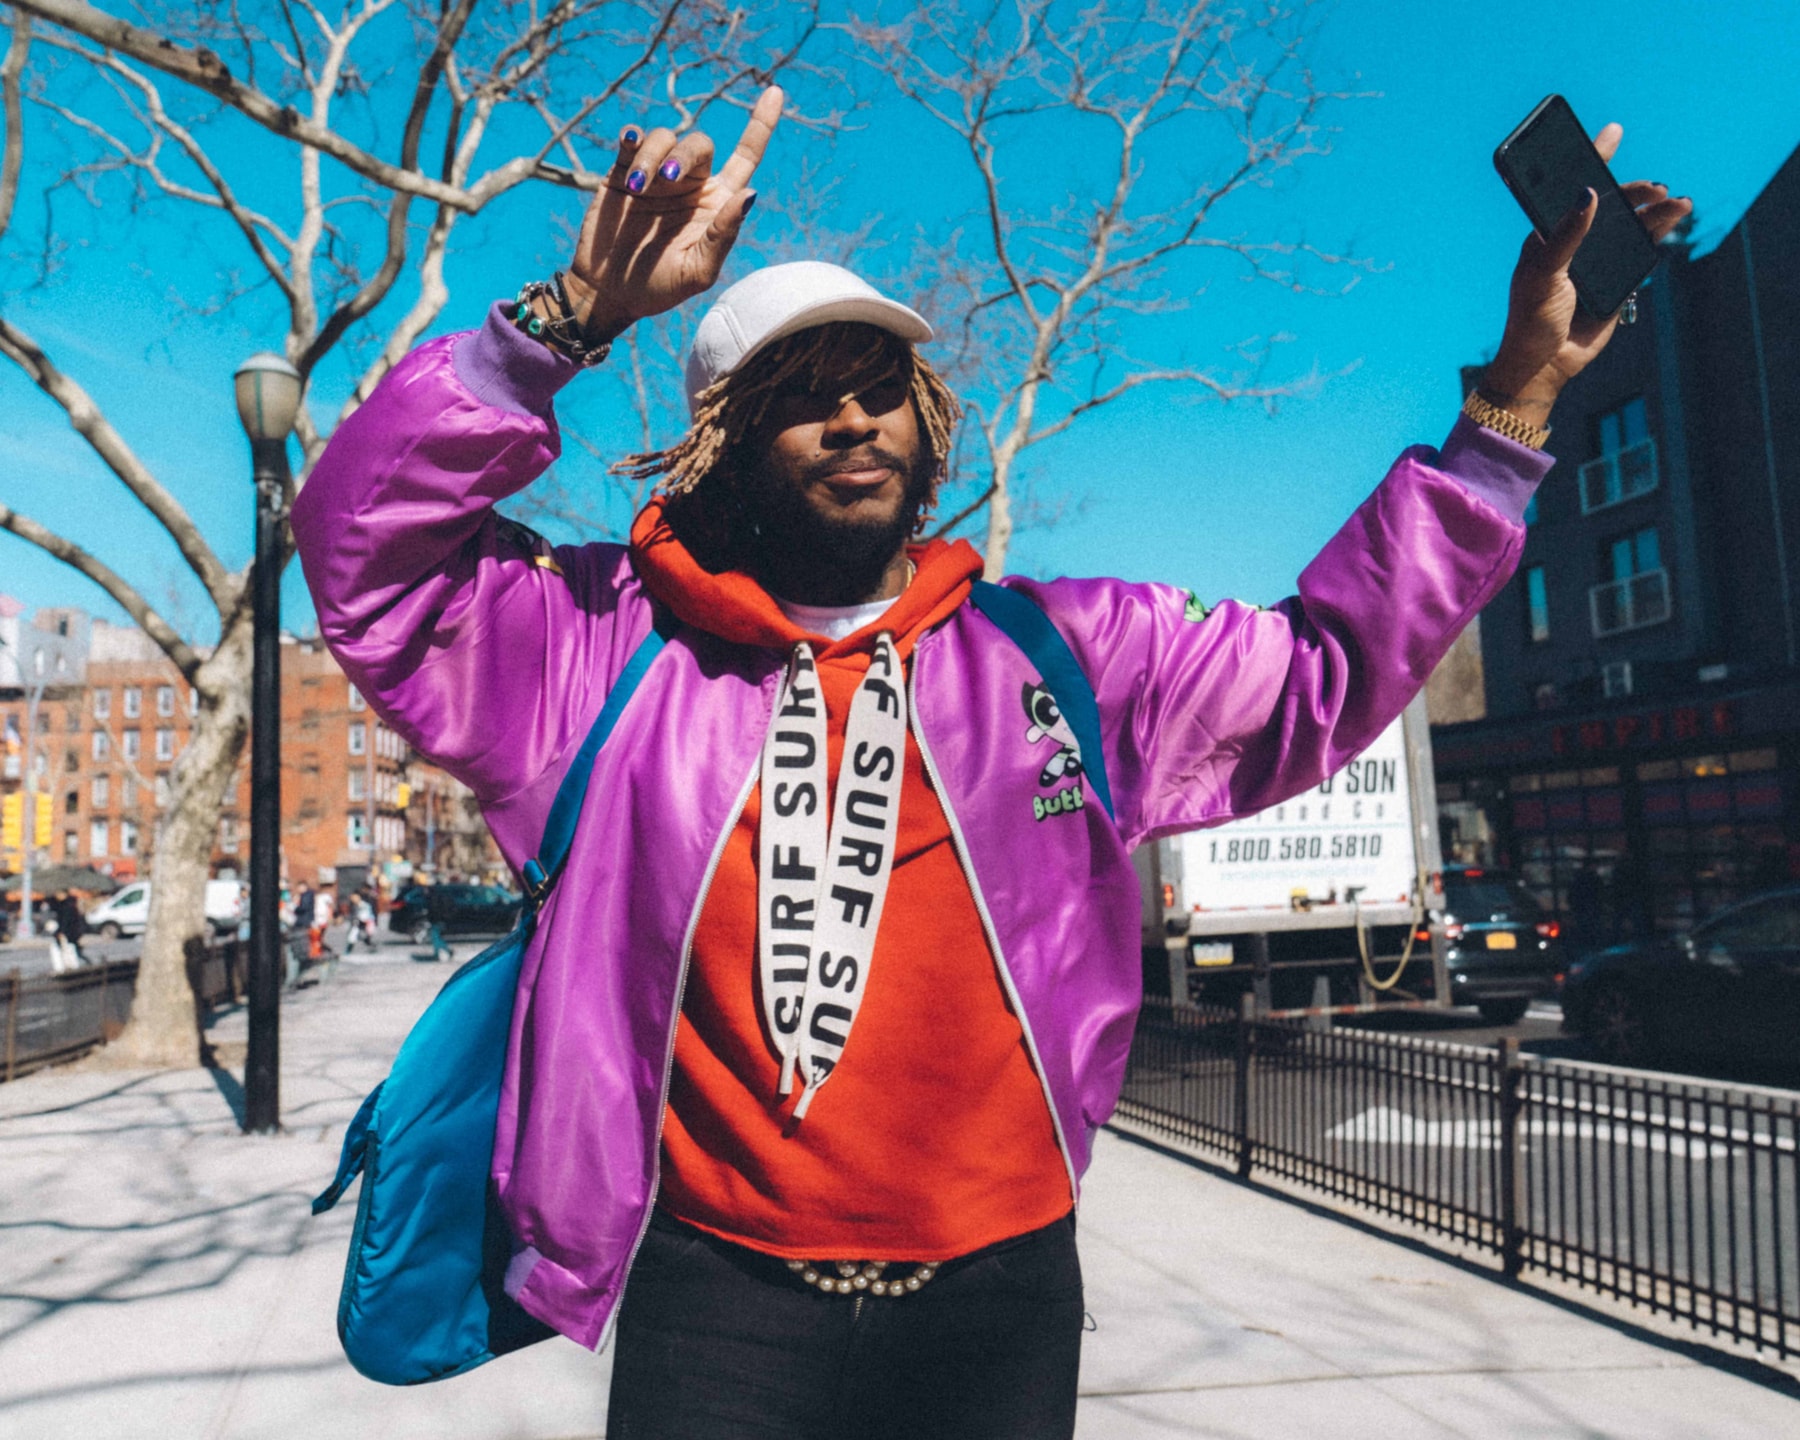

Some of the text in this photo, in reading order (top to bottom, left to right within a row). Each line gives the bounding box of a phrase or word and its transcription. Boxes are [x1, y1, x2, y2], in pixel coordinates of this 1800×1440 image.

[1346, 758, 1397, 796] SON
[831, 741, 896, 929] SURF
[1208, 834, 1384, 864] 1.800.580.5810
[770, 844, 816, 1035] SURF
